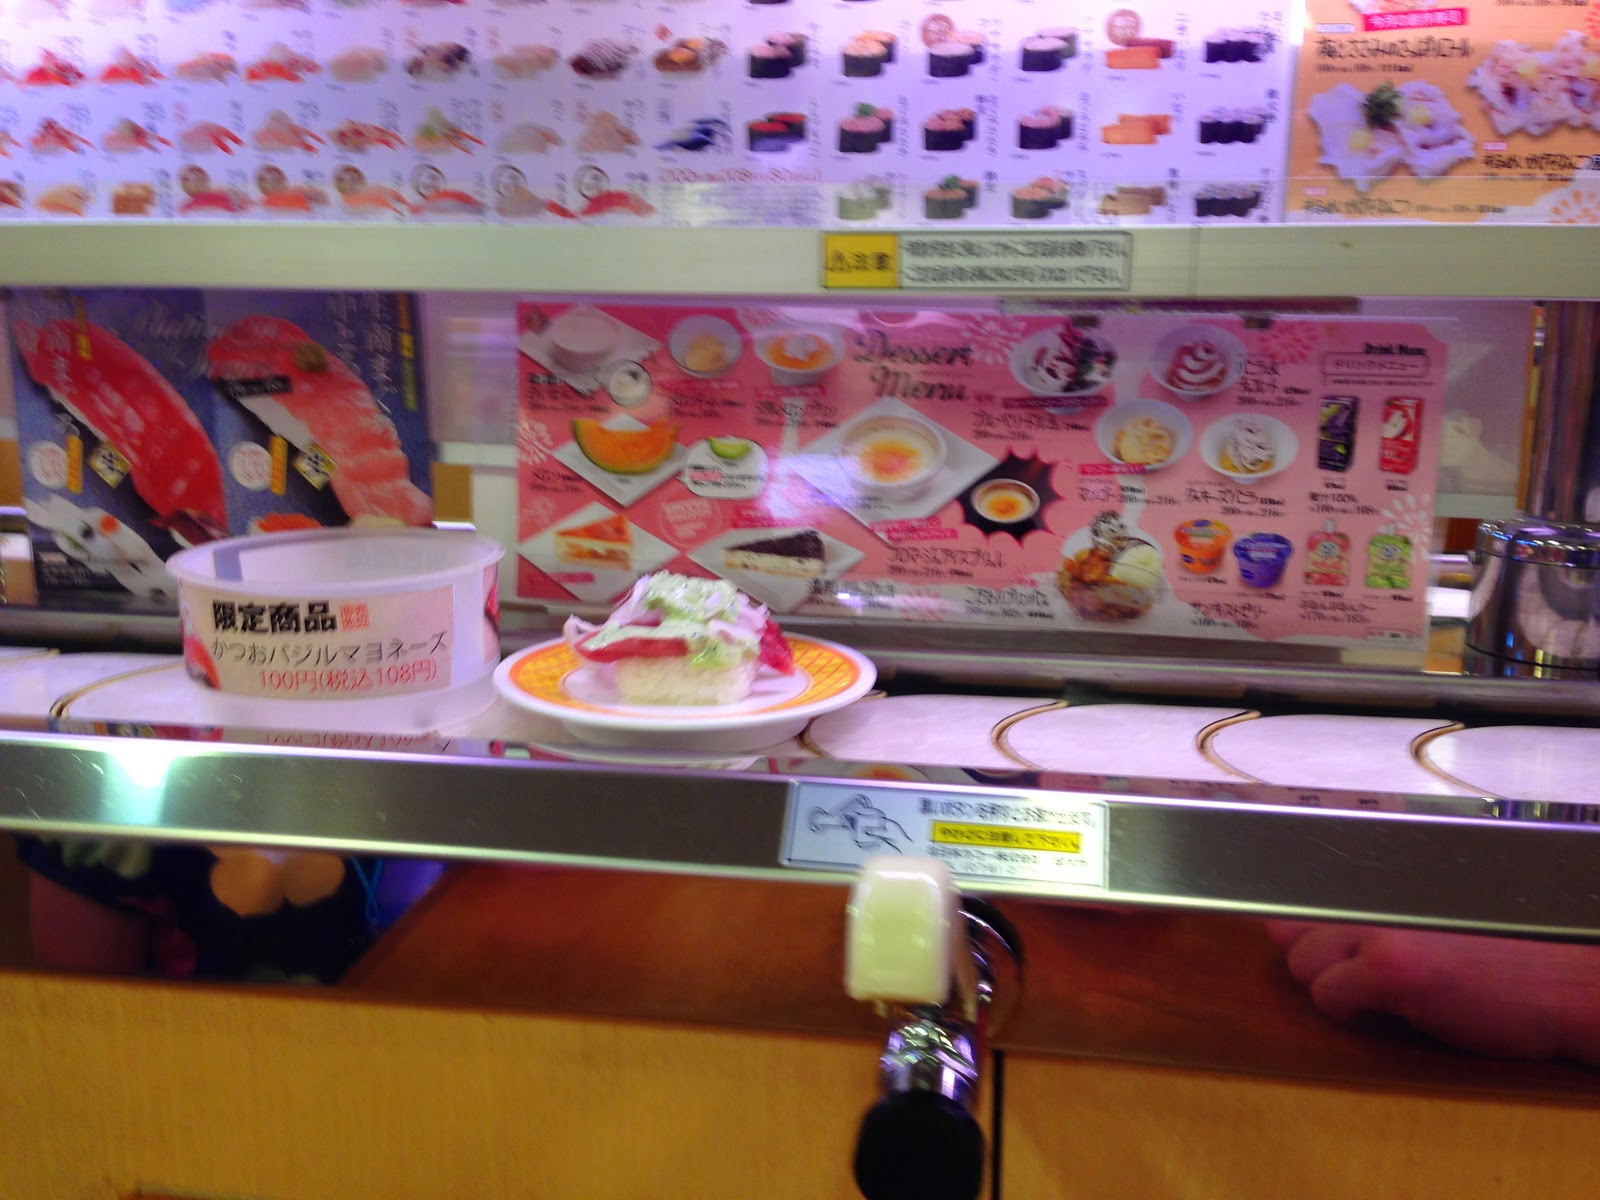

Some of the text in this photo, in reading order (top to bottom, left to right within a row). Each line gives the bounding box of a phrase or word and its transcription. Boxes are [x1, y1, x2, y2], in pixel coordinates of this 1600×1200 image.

[212, 601, 337, 633] 限定商品
[212, 629, 447, 667] かつおバジルマヨネーズ
[259, 658, 436, 693] 100円(税込108円)
